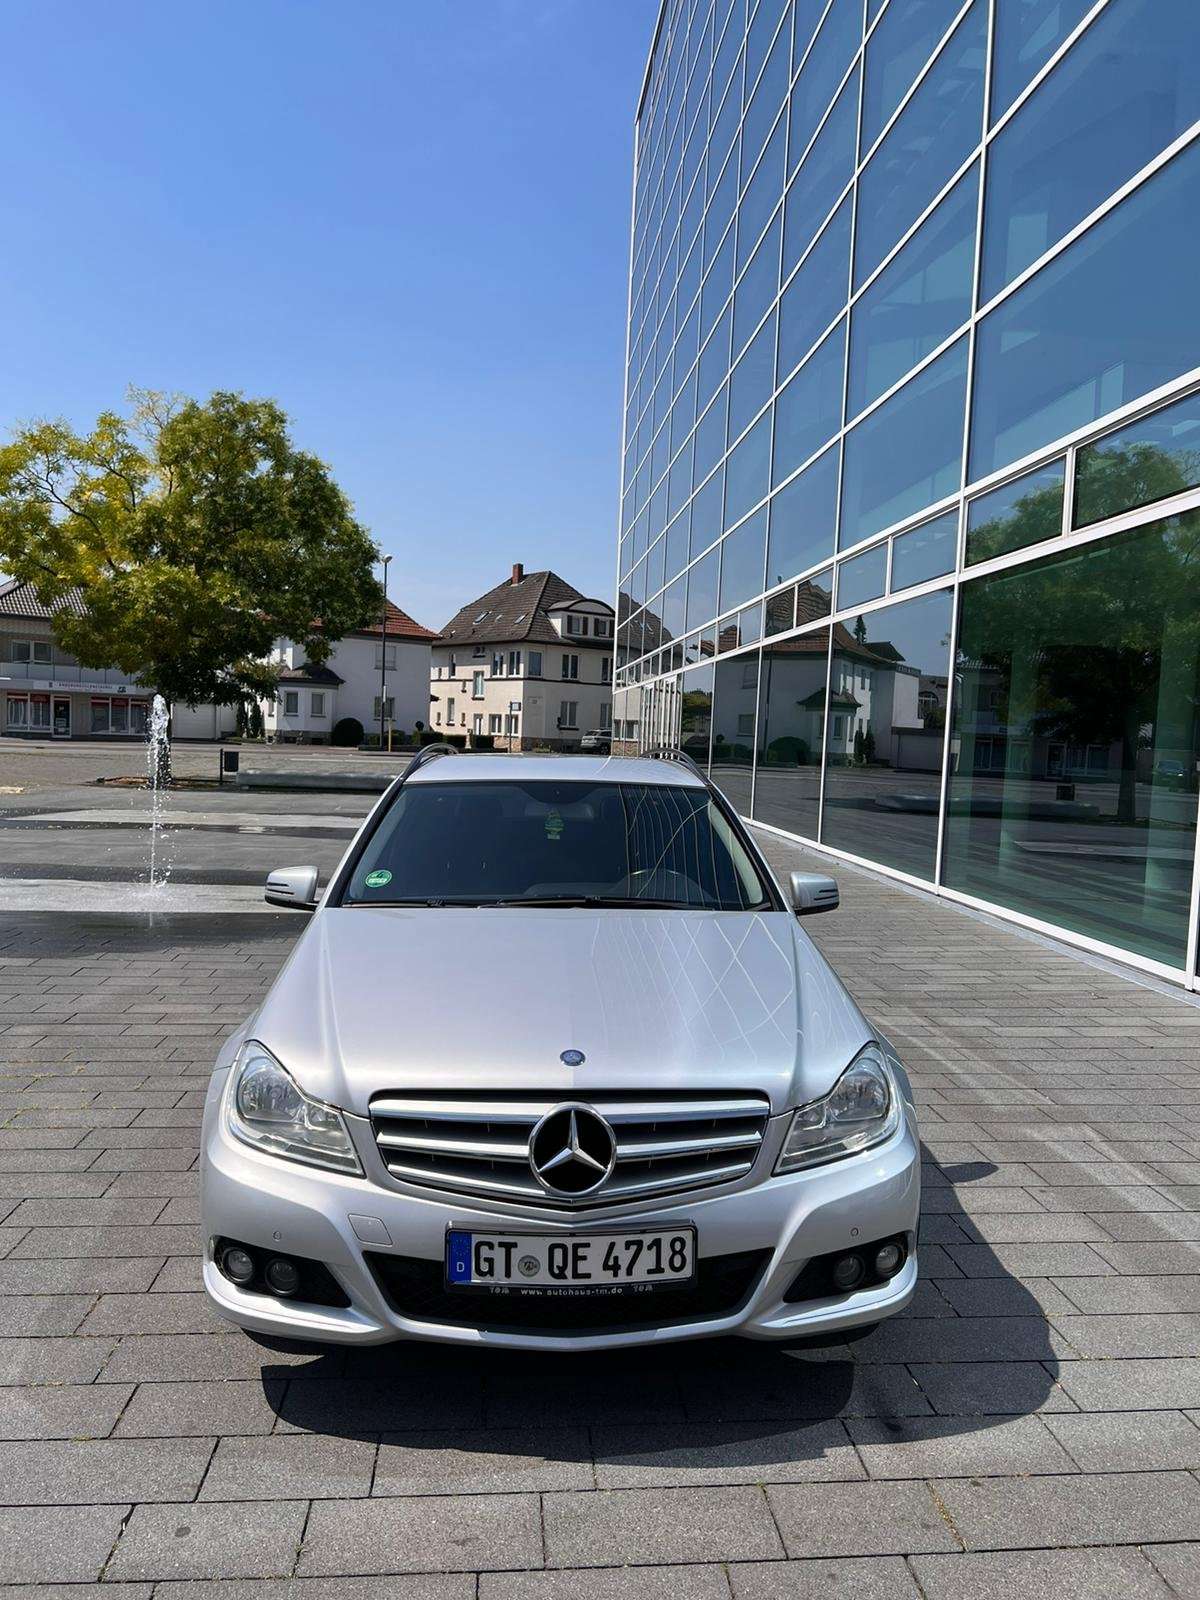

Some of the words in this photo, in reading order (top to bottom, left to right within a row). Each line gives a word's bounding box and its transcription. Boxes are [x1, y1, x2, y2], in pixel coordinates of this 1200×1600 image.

[456, 1261, 465, 1272] D
[474, 1240, 518, 1279] GT
[547, 1242, 592, 1280] QE
[602, 1236, 688, 1278] 4718
